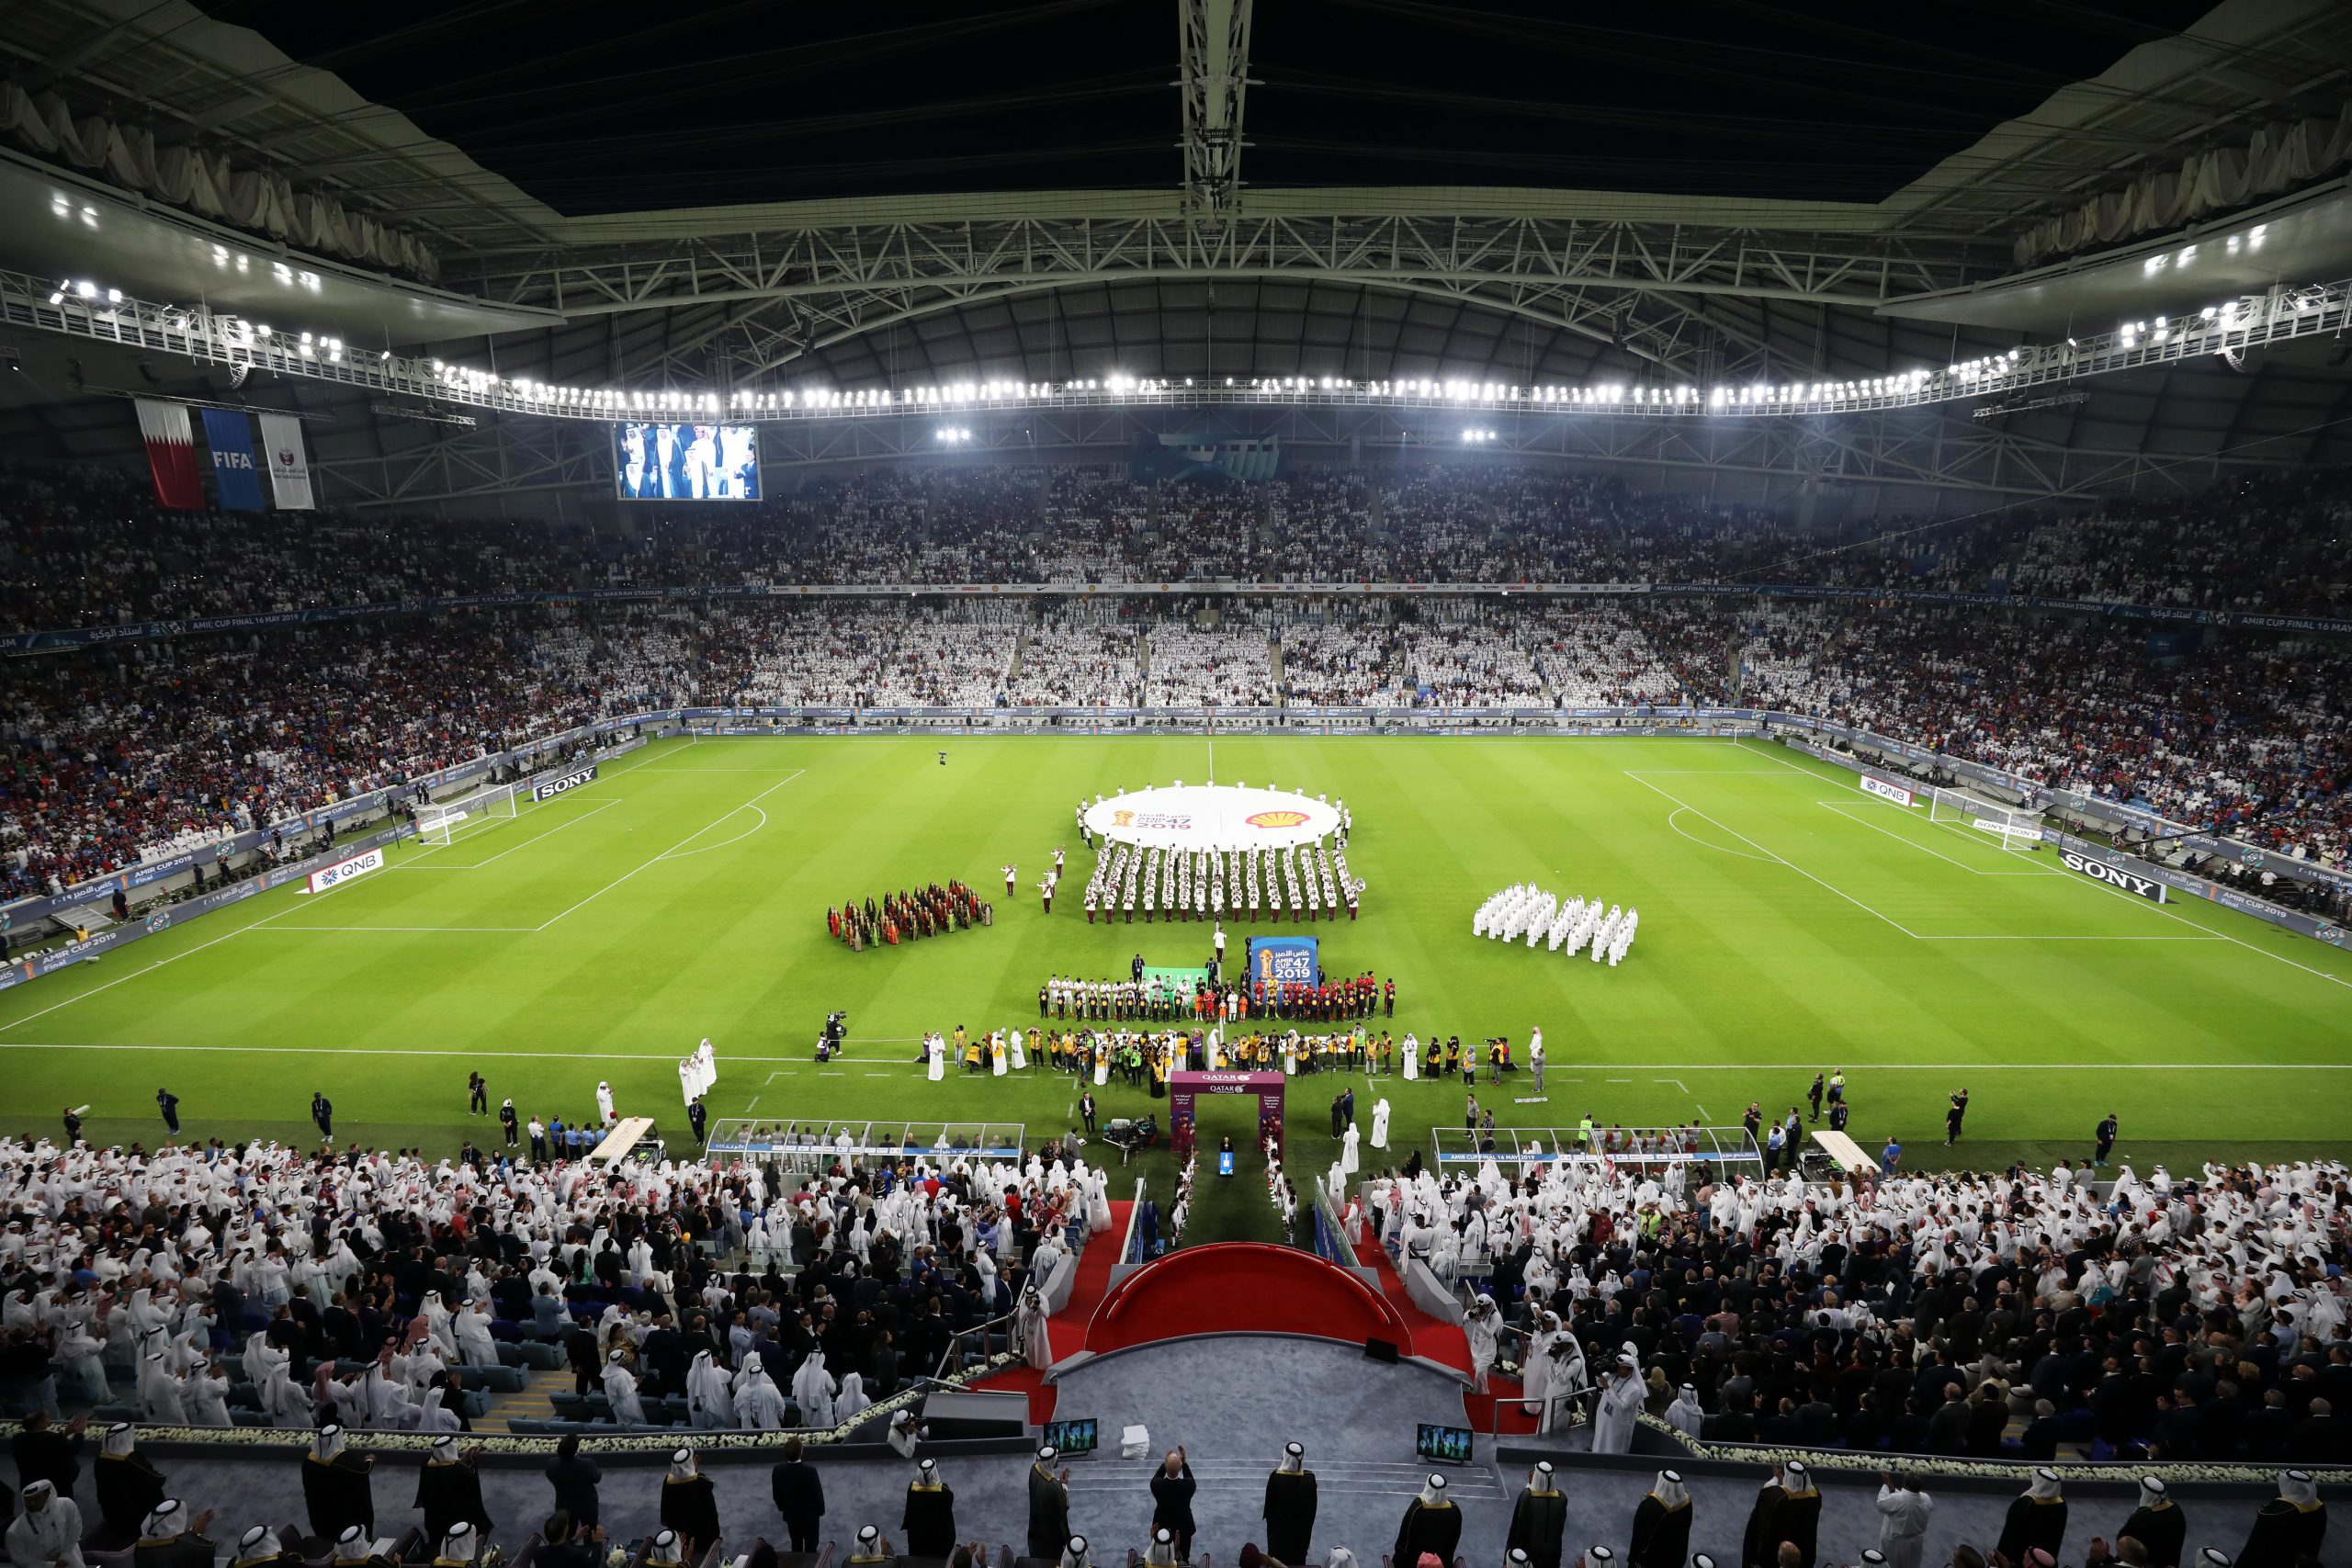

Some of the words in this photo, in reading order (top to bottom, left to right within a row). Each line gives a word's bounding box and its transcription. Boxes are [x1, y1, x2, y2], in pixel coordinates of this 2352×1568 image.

[212, 451, 253, 469] FIFA
[634, 589, 663, 597] STADIUM
[2048, 601, 2075, 609] WAKRAH
[2075, 604, 2104, 612] STADIUM
[215, 619, 231, 628] CUP
[232, 617, 254, 627] FINAL
[256, 615, 265, 625] 16
[266, 615, 281, 625] MAY
[282, 613, 300, 623] 2019
[2242, 616, 2265, 626] AMIR
[2266, 618, 2286, 627] CUP
[2287, 620, 2315, 629] FINAL
[2318, 622, 2330, 631] 16
[2330, 624, 2352, 633] MAY
[464, 764, 476, 773] 2019
[541, 769, 594, 798] SONY
[2018, 782, 2030, 790] AMIR
[2041, 787, 2054, 796] 2019
[1879, 784, 1905, 800] QNB
[317, 809, 330, 819] AMIR
[329, 806, 343, 816] CUP
[342, 802, 357, 813] 2019
[1976, 821, 2004, 830] SONY
[2009, 828, 2038, 837] SONY
[2073, 839, 2088, 848] 2019
[2199, 836, 2218, 847] 2019
[134, 866, 157, 878] AMIR
[156, 861, 173, 872] CUP
[173, 855, 193, 866] 2019
[271, 868, 288, 880] AMIR
[288, 863, 303, 874] CUP
[302, 858, 319, 870] 2019
[341, 854, 378, 876] QNB
[2065, 853, 2154, 896] SONY
[2152, 868, 2169, 879] ٢٠١٩
[2299, 866, 2317, 877] ٢٠١٩
[94, 880, 114, 892] كأس
[135, 875, 153, 885] Final
[271, 877, 287, 886] Final
[2186, 877, 2203, 889] كأس
[237, 882, 254, 893] كأس
[51, 894, 73, 906] ٢٠١٩
[203, 893, 221, 907] ٢٠١٩
[2222, 899, 2239, 909] Final
[2222, 891, 2245, 904] AMIR
[2245, 898, 2263, 910] CUP
[2263, 905, 2287, 919] 2019
[42, 951, 70, 964] AMIR
[71, 943, 92, 954] CUP
[93, 932, 117, 943] 2019
[1293, 949, 1310, 958] كأس
[43, 959, 67, 973] Final
[1293, 957, 1310, 968] 47
[1274, 968, 1311, 978] 2019
